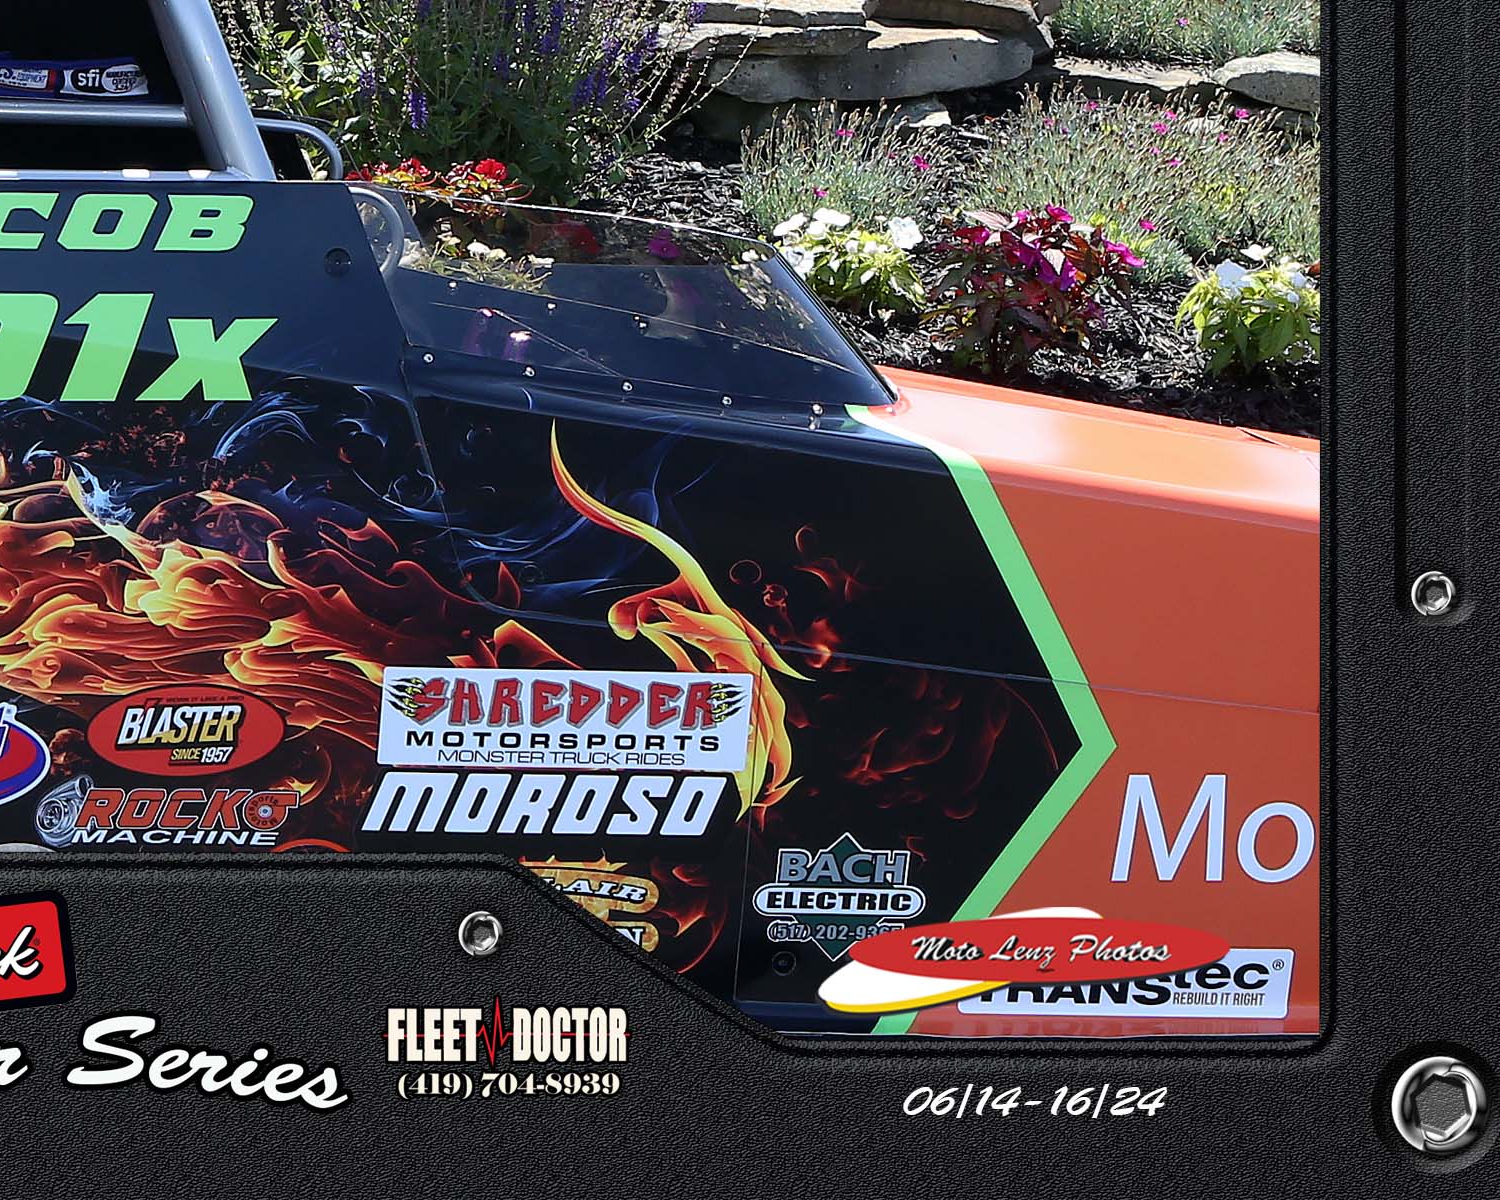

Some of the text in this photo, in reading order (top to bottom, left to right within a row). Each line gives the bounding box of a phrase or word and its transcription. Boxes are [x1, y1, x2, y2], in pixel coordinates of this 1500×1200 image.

[77, 68, 100, 87] sfi
[408, 677, 718, 729] SHREDDER
[117, 705, 242, 745] BLASTER
[406, 731, 720, 751] MOTORSPORTS
[171, 747, 233, 763] SINCE 1957
[438, 750, 685, 766] MONSTER TRUCK RIDES
[360, 772, 727, 836] MOROSO
[71, 830, 279, 846] MACHINE
[780, 853, 906, 884] BACH
[766, 891, 912, 911] ELECTRIC
[770, 924, 811, 940] (517)
[1173, 992, 1264, 1006] REBUILD IT RIGHT
